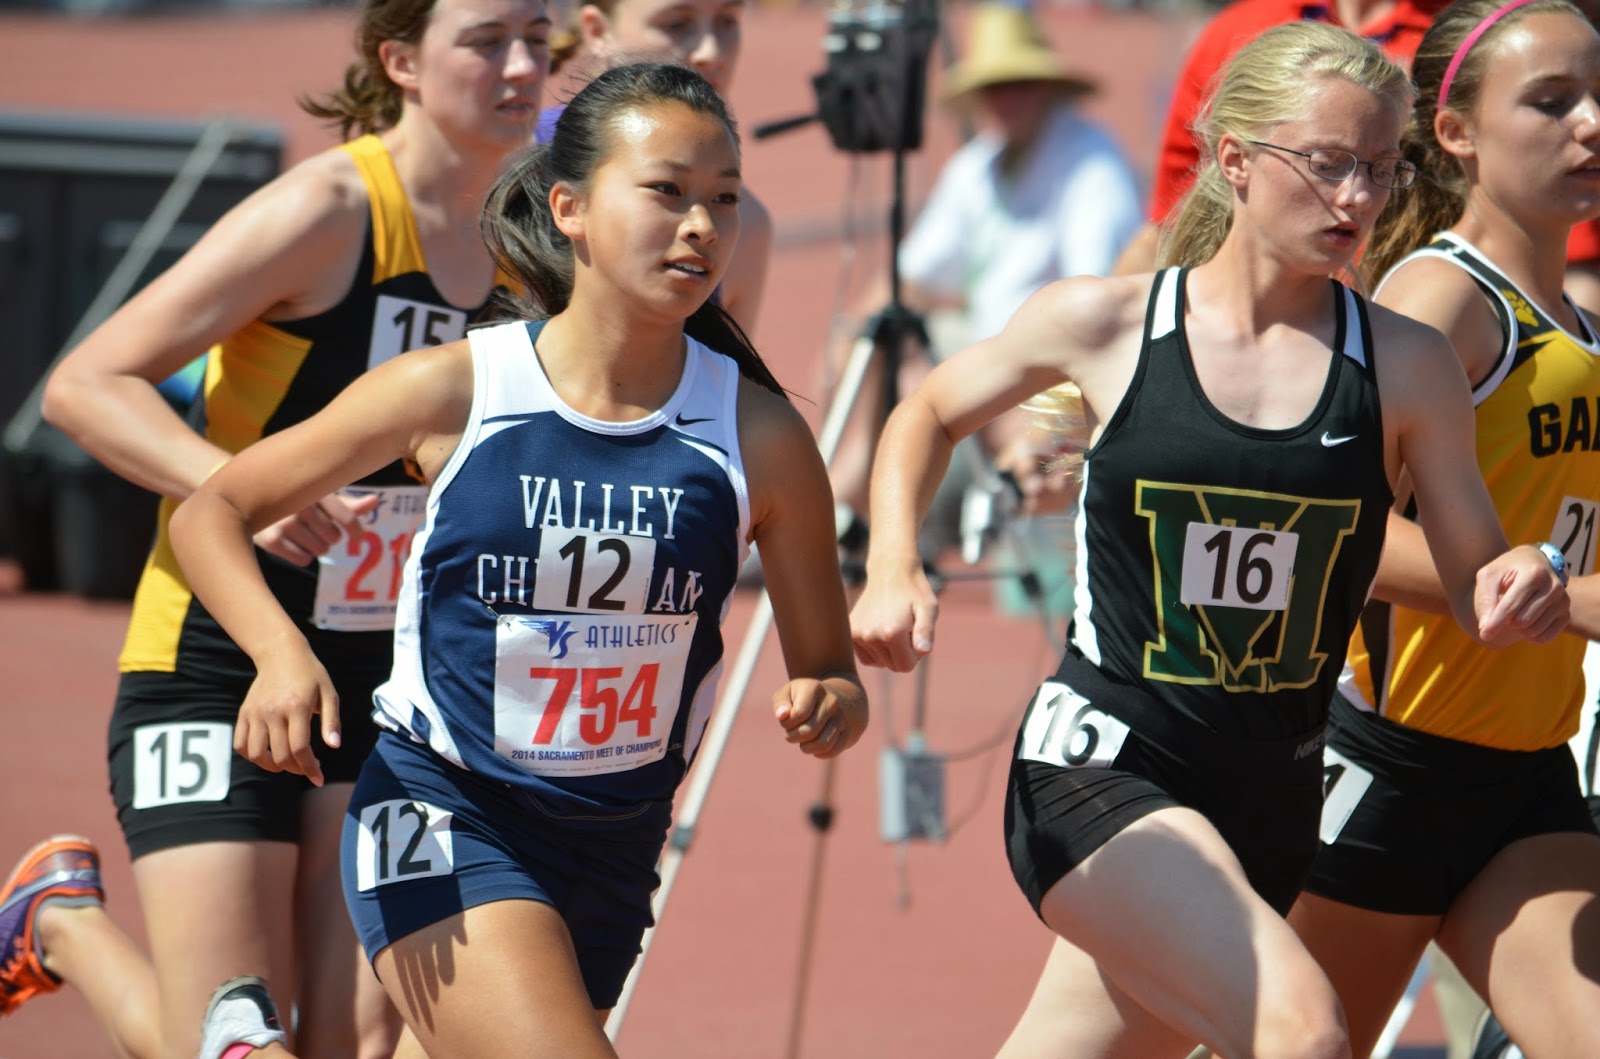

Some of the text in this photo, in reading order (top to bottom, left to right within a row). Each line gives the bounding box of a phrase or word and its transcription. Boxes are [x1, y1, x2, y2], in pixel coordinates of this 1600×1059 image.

[519, 474, 684, 540] VALLEY
[1560, 503, 1596, 577] 21
[344, 528, 417, 602] 21
[559, 535, 632, 611] 12
[1203, 530, 1276, 604] 16
[584, 622, 680, 649] ATHLETICS
[530, 663, 660, 746] 754
[1038, 691, 1100, 767] 16
[149, 729, 211, 800] 15
[511, 750, 536, 760] 2014
[538, 750, 595, 762] SACRAMENTO
[596, 747, 614, 760] MEET
[615, 746, 625, 756] OF
[371, 801, 432, 880] 12
